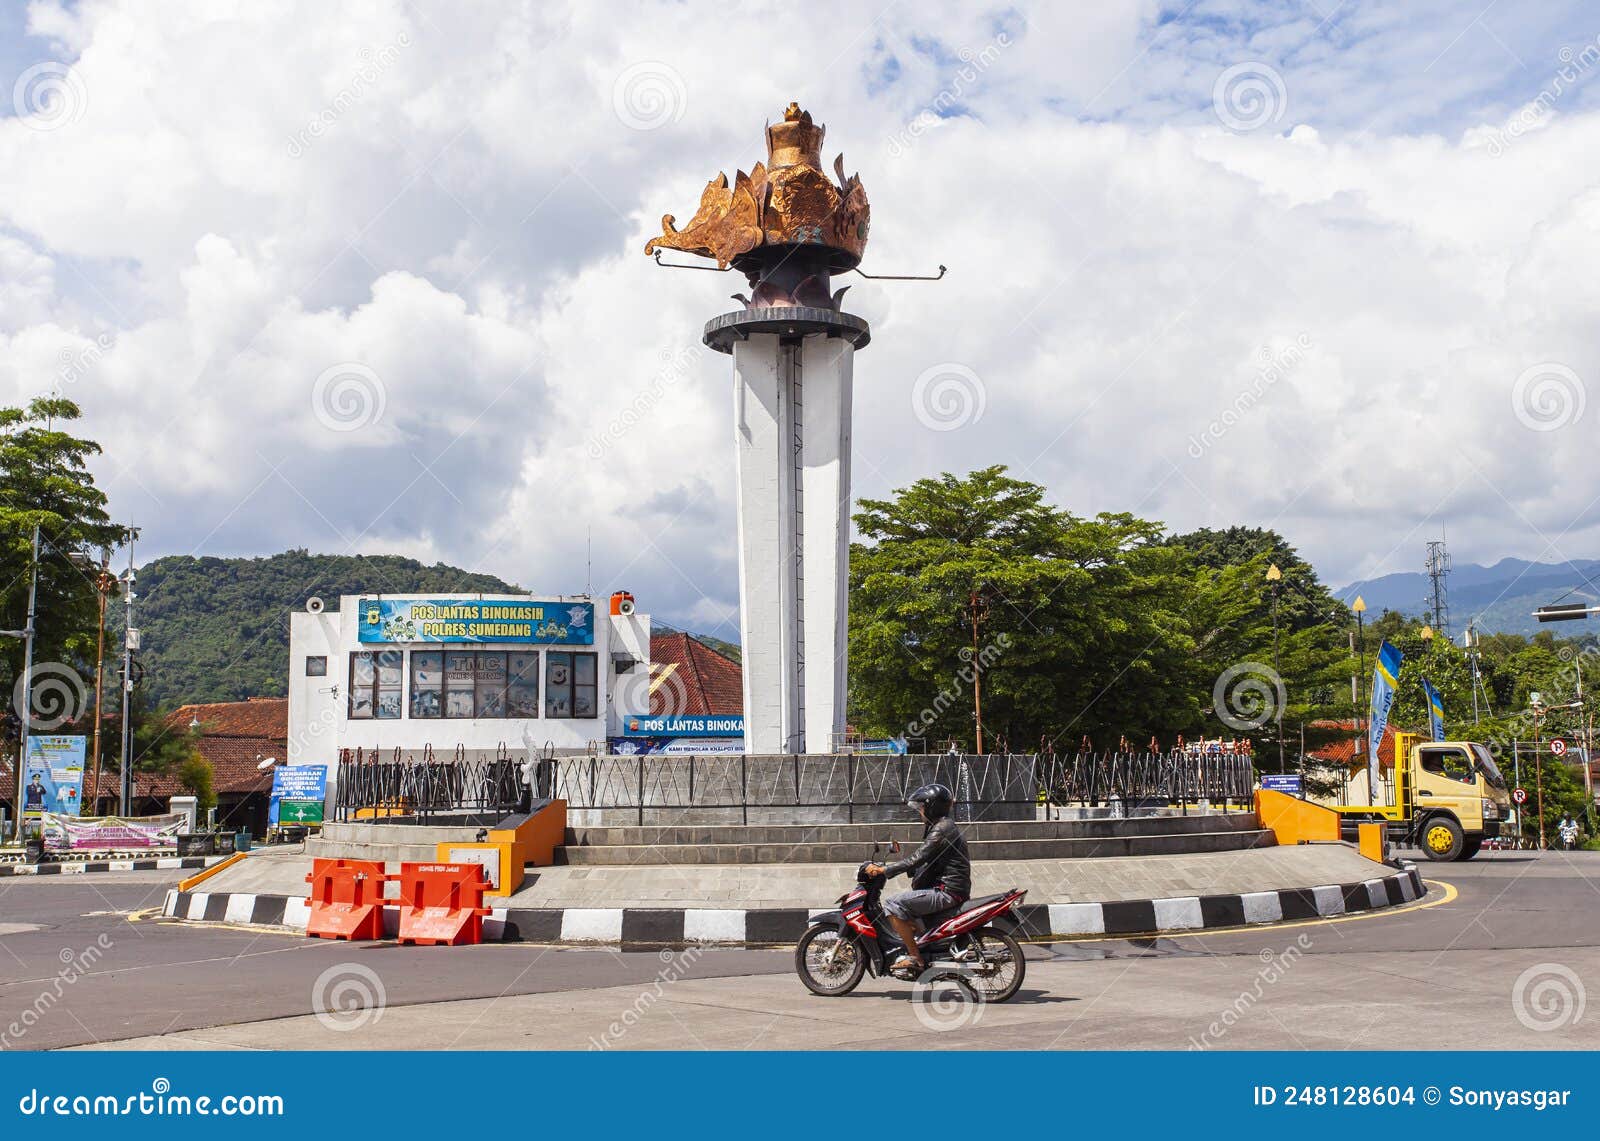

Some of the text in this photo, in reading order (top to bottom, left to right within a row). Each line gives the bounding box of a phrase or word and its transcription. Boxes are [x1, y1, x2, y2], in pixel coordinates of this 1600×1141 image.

[411, 606, 435, 619] POS
[436, 606, 479, 619] LANTAS
[423, 623, 531, 636] POLRES SUMEDANG
[451, 656, 500, 671] TMC
[644, 720, 664, 731] POS
[667, 720, 704, 731] LANTAS
